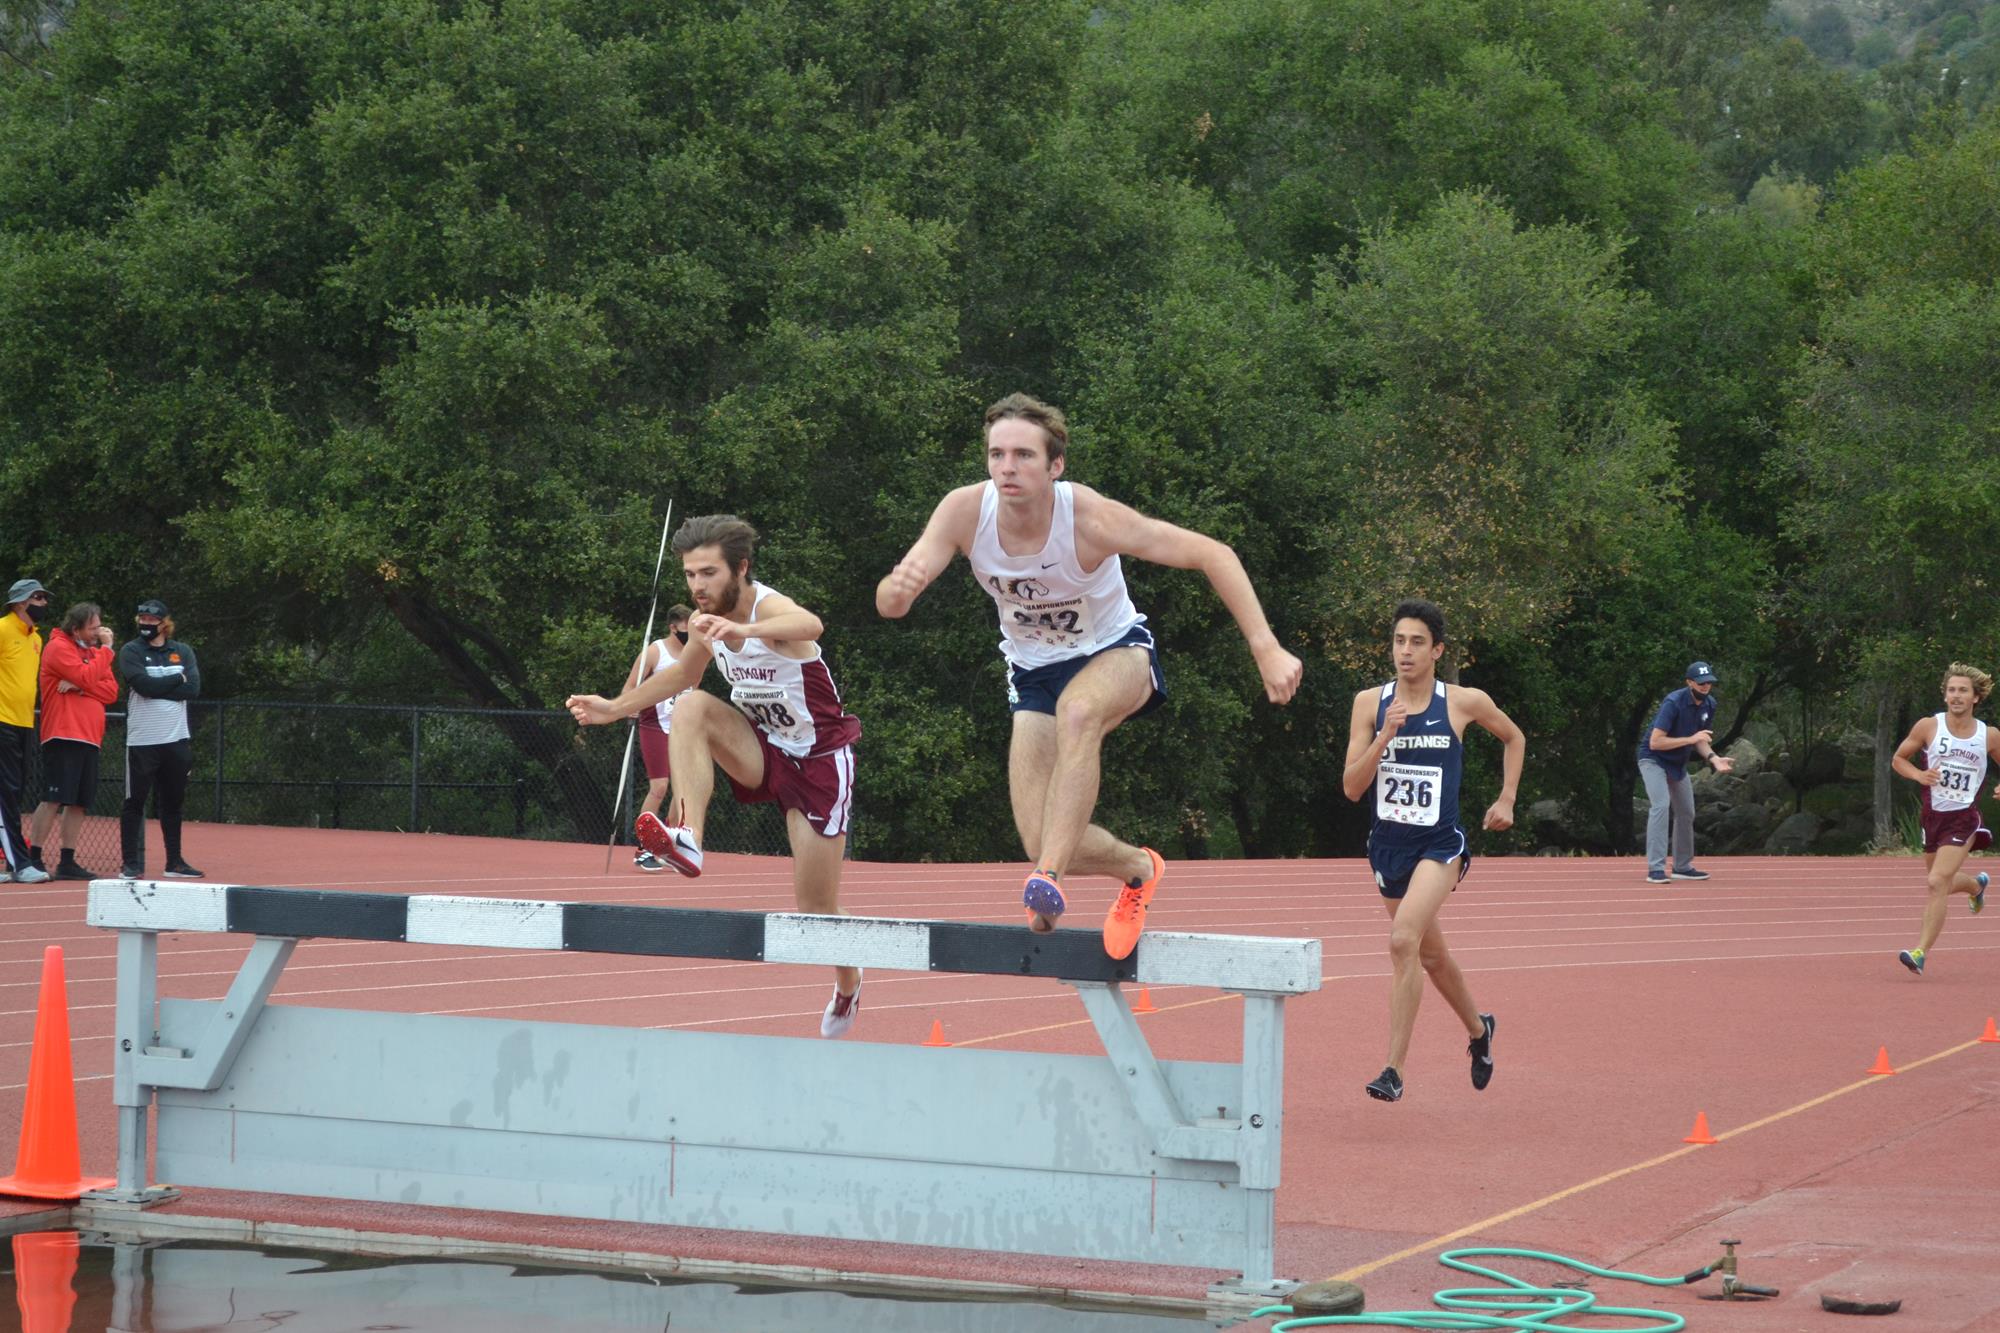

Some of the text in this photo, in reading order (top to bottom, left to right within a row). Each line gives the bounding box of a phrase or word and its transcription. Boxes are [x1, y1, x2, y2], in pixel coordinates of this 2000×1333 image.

[1698, 666, 1710, 675] M
[1938, 737, 1949, 755] 5
[1395, 767, 1439, 777] CHAMPIONSHIPS
[1940, 769, 1971, 792] 331
[1384, 777, 1433, 808] 236
